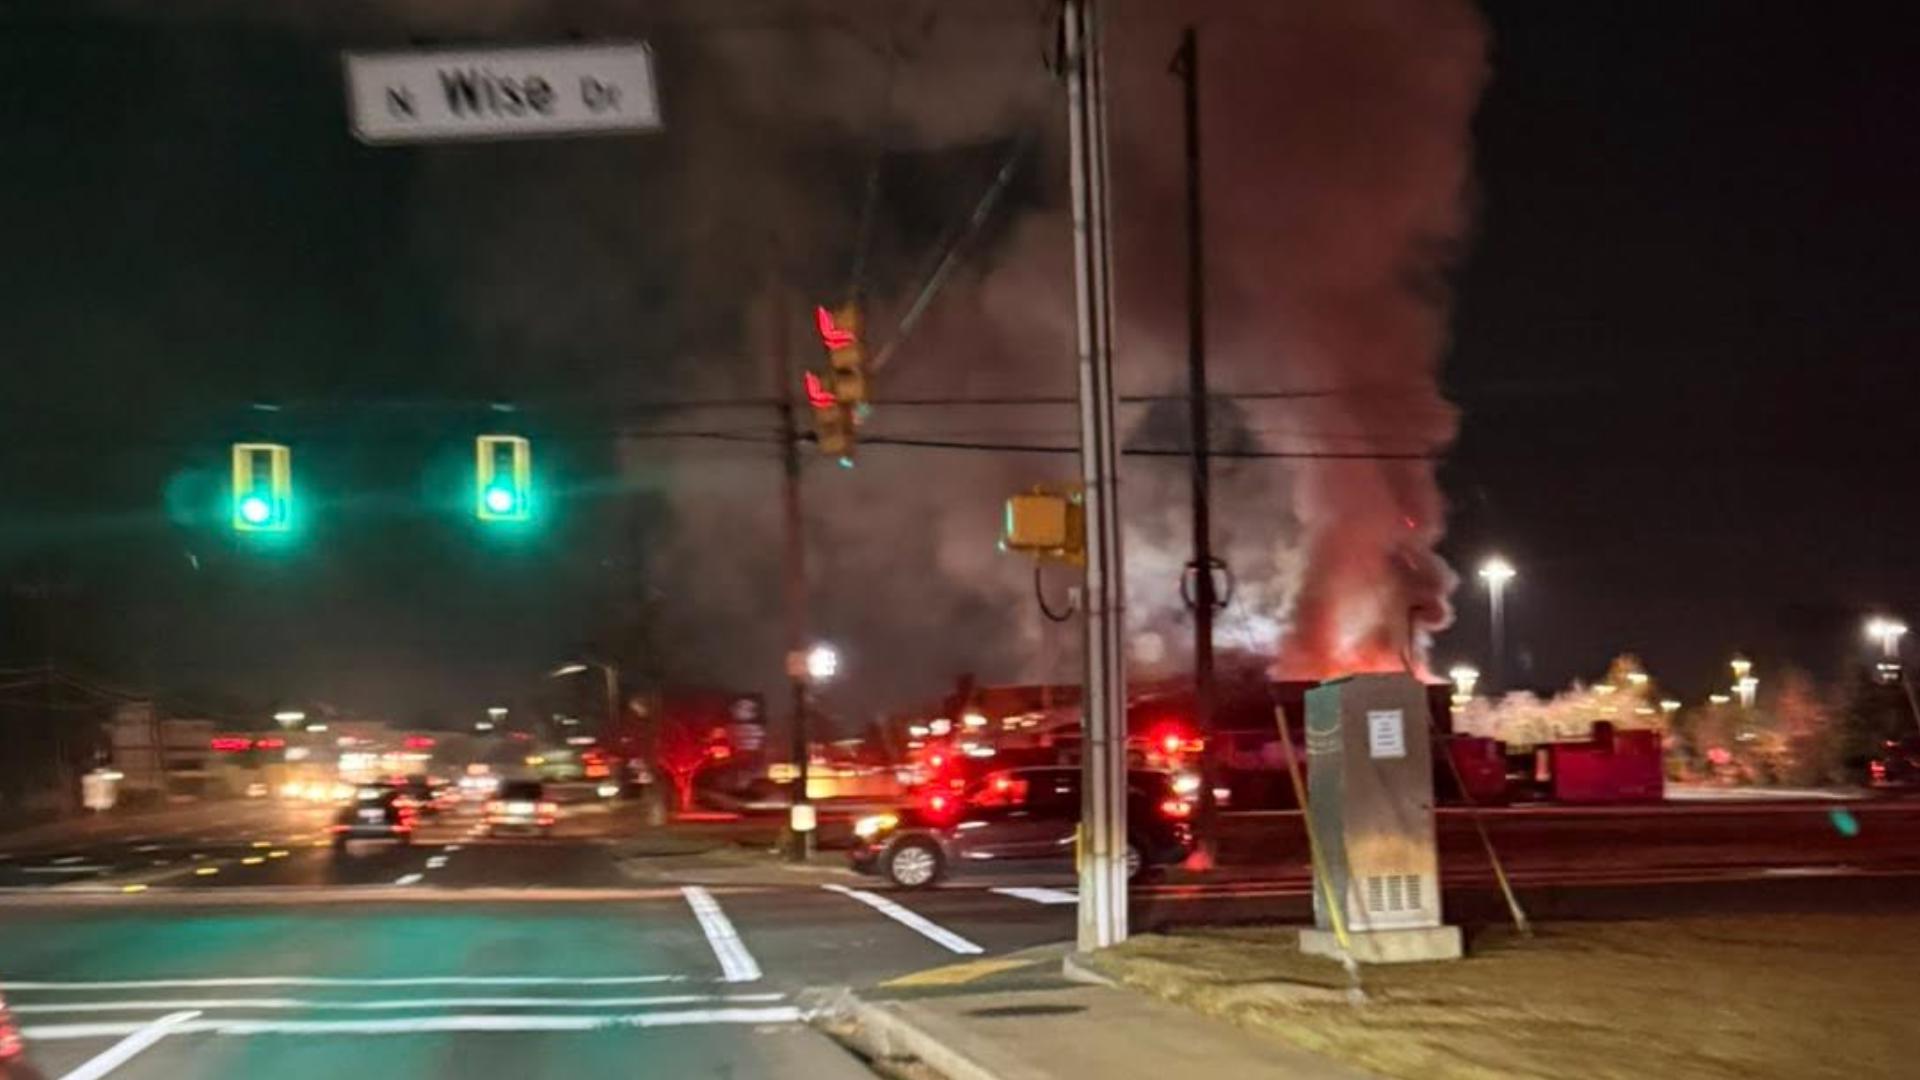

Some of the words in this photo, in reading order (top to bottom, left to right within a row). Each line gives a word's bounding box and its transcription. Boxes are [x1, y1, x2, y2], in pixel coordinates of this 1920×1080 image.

[385, 85, 417, 119] N
[438, 65, 555, 117] Wise
[578, 74, 622, 114] Dr
